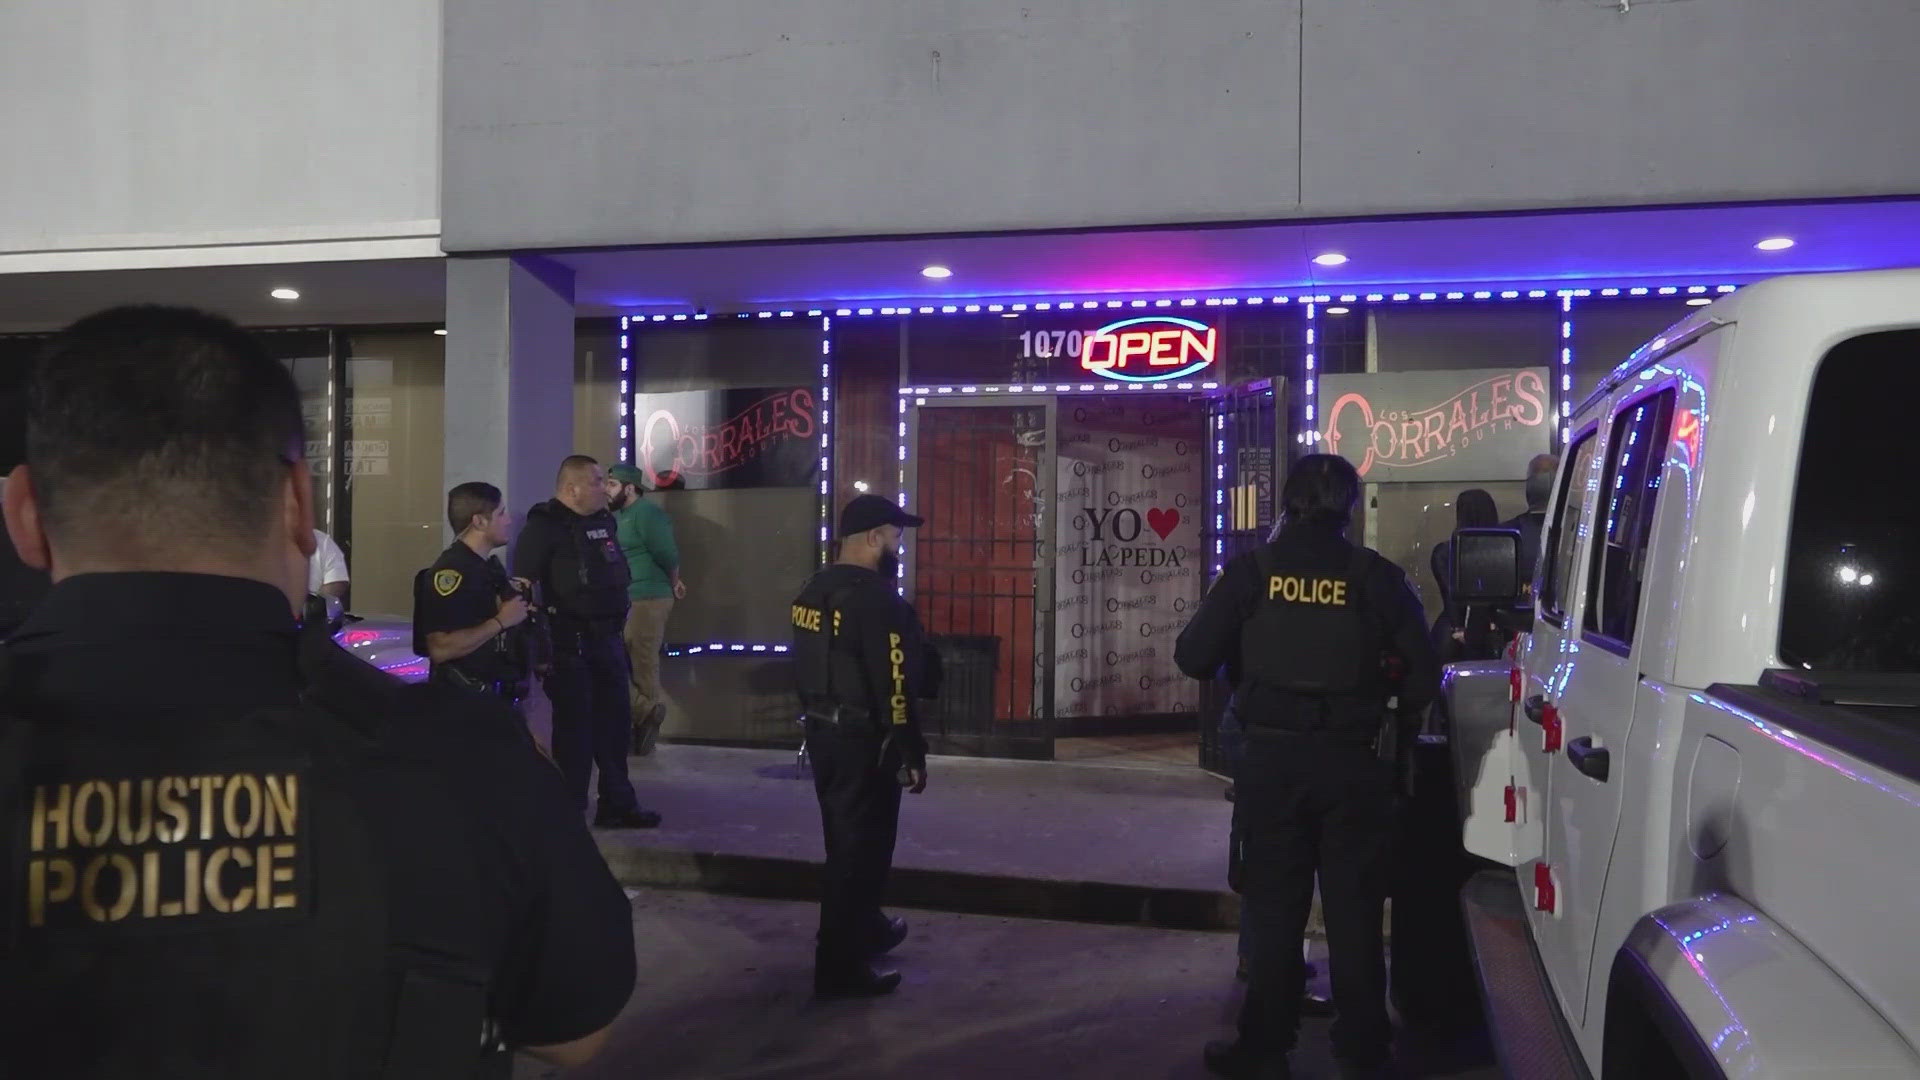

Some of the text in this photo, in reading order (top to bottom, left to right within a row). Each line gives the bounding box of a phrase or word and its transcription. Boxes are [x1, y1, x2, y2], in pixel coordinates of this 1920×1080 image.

[1081, 328, 1216, 370] OPEN
[1323, 371, 1545, 477] CORRALES
[1380, 409, 1408, 421] LOS
[640, 389, 814, 488] CORRALES
[1450, 420, 1512, 457] SOUTH
[1082, 507, 1142, 542] YO
[1081, 547, 1112, 567] LA
[1120, 547, 1181, 567] PEDA
[1269, 576, 1346, 605] POLICE
[792, 604, 821, 632] POLICE
[889, 632, 907, 725] POLICE
[30, 774, 297, 851] HOUSTON
[28, 843, 297, 927] POLICE
